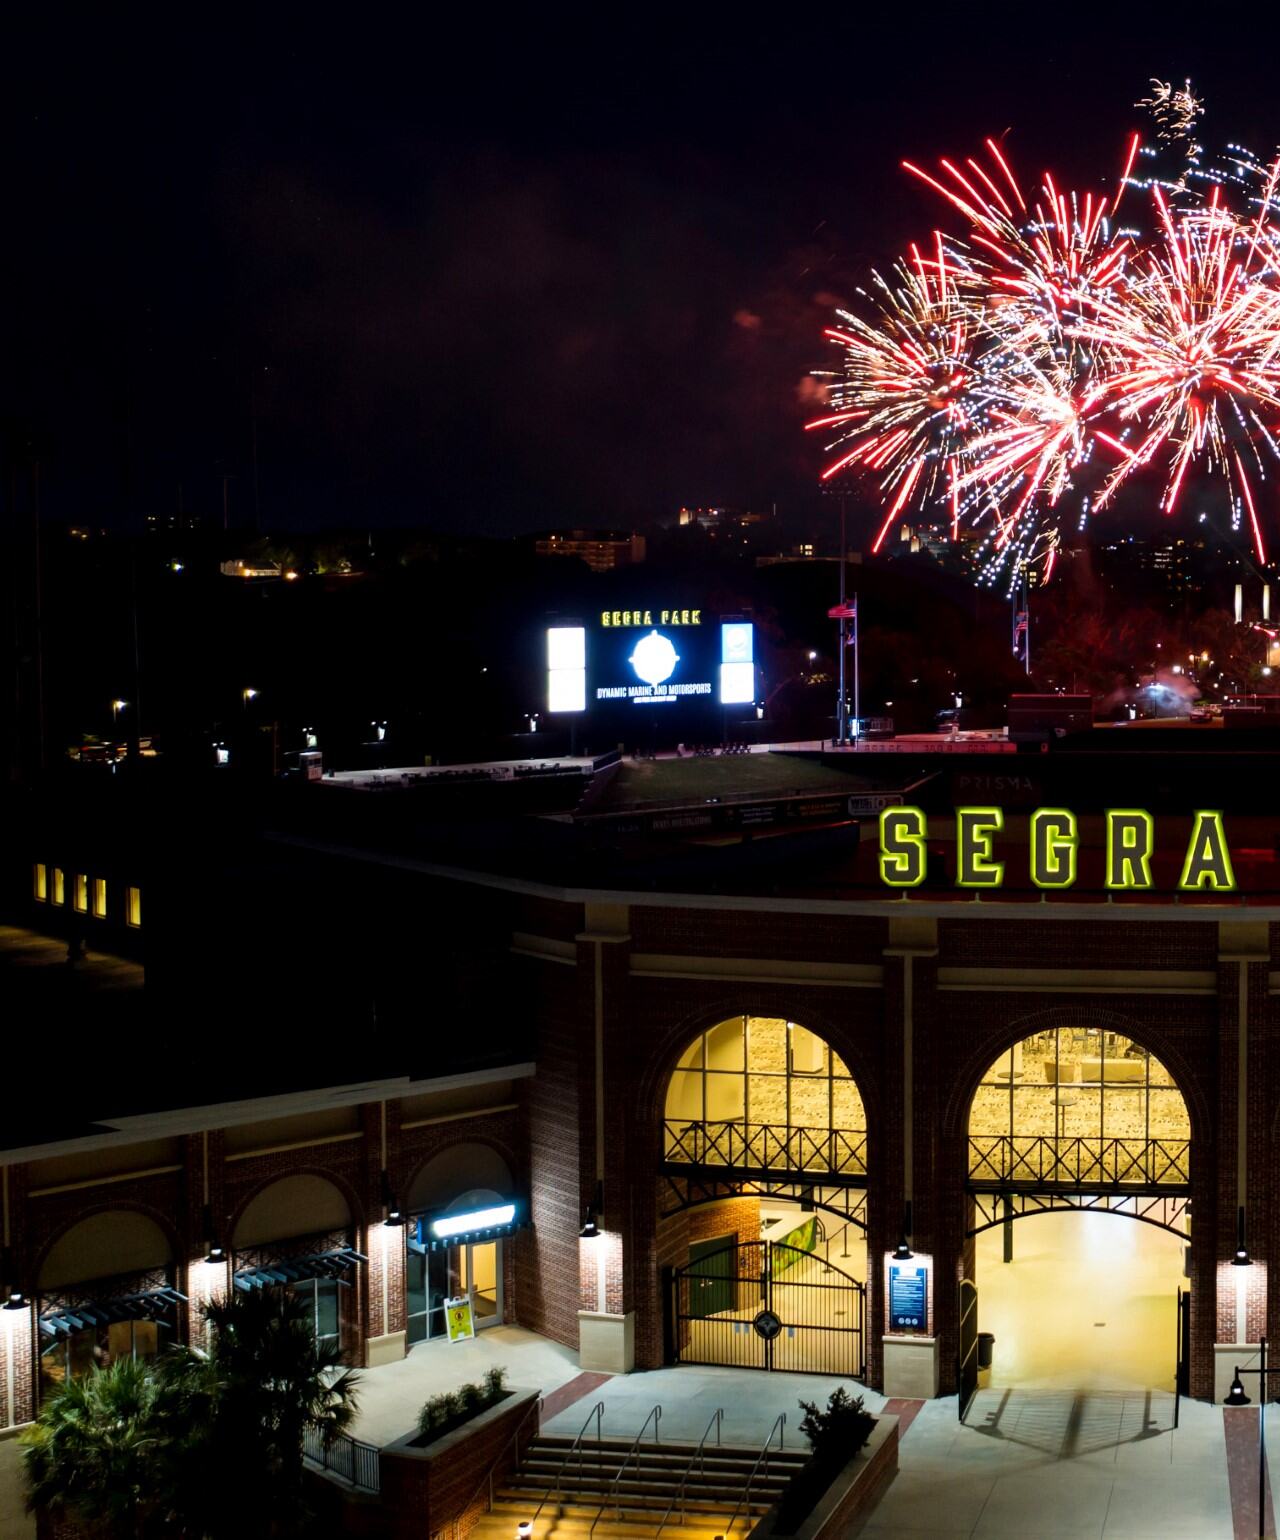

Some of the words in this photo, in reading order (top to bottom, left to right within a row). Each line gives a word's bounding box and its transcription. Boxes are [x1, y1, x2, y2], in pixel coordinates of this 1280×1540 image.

[661, 609, 702, 625] PARK
[597, 687, 627, 699] DYNAMIC
[628, 686, 653, 697] MARINE
[654, 685, 667, 695] AND
[668, 683, 711, 695] MOTORSPORTS
[879, 806, 1236, 891] SEGRA
